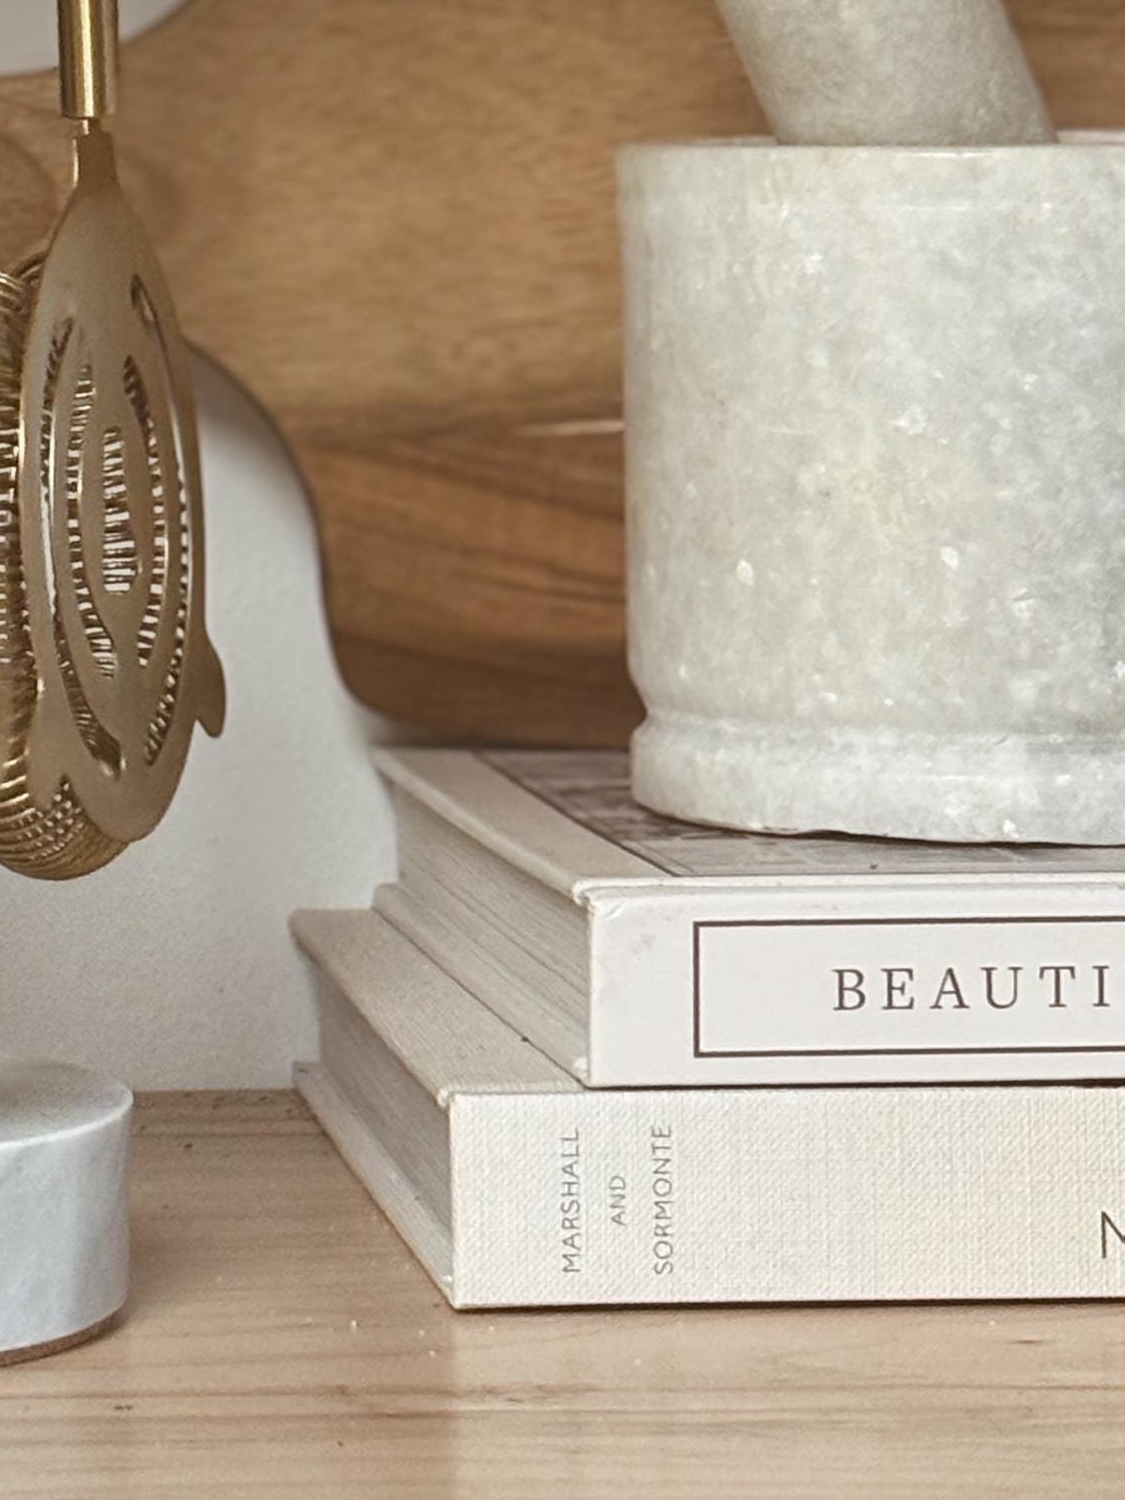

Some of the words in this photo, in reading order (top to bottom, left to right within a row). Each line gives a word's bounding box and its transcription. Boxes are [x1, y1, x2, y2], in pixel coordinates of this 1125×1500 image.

[832, 965, 1111, 1011] BEAUTI
[560, 1128, 581, 1273] MARSHALL
[609, 1174, 626, 1227] AND
[652, 1124, 673, 1276] SORMONTE
